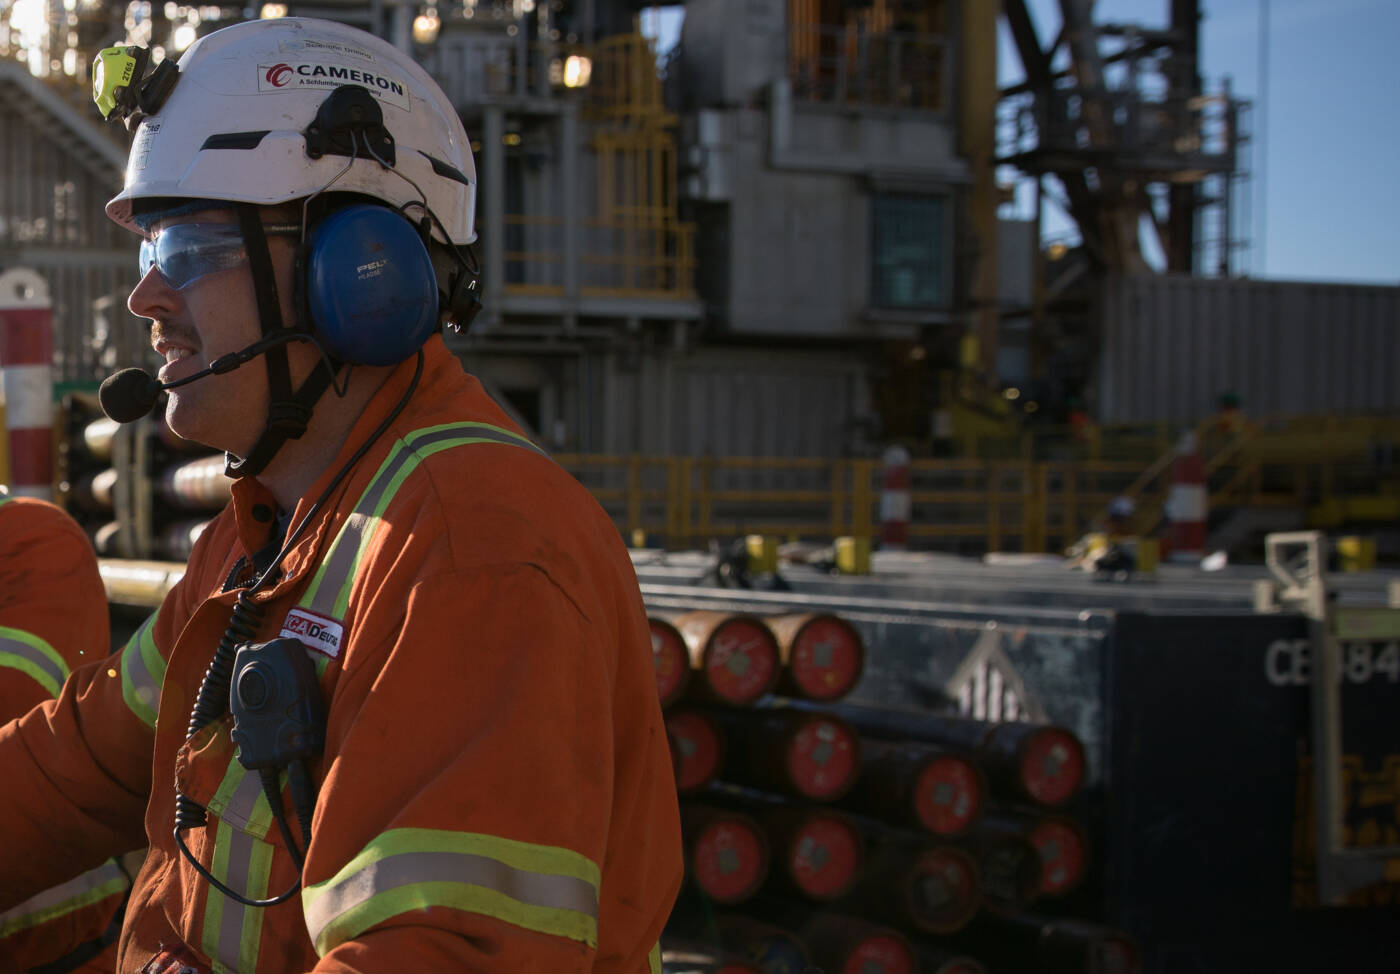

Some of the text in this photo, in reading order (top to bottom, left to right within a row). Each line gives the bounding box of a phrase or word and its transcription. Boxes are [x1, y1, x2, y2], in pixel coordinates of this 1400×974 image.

[122, 62, 134, 81] 2765
[297, 64, 403, 96] CAMERON
[305, 79, 345, 88] Schlumber
